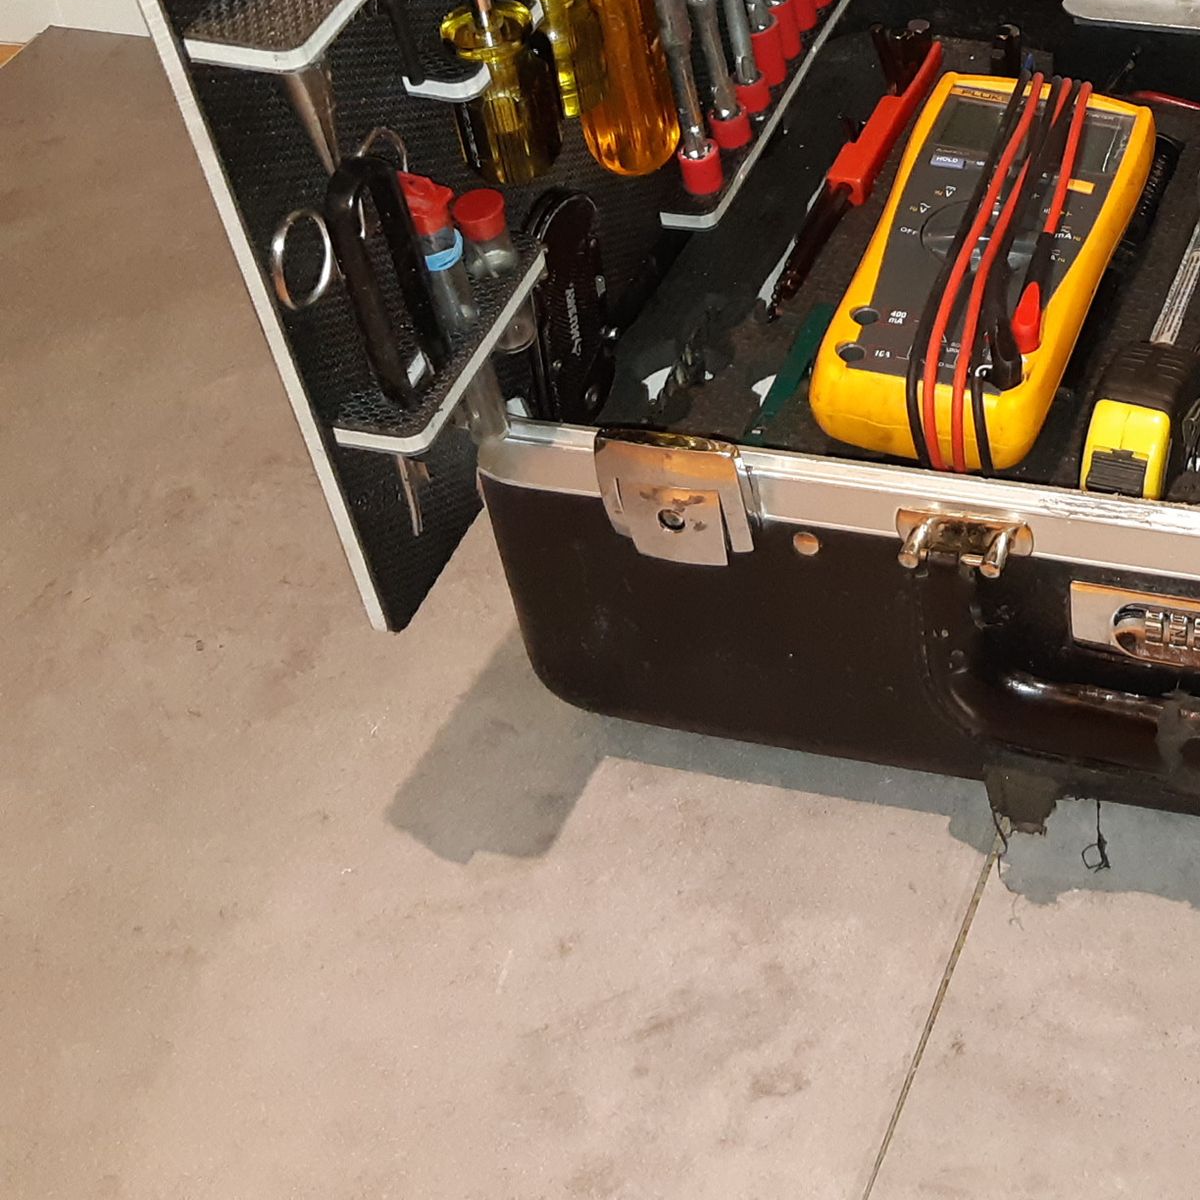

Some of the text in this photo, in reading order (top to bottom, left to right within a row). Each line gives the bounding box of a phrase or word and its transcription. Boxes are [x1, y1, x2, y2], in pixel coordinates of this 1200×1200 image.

[935, 155, 959, 164] HOLD
[900, 226, 917, 235] OFF
[1054, 232, 1072, 240] mA
[890, 310, 907, 319] 400
[888, 316, 903, 325] mA
